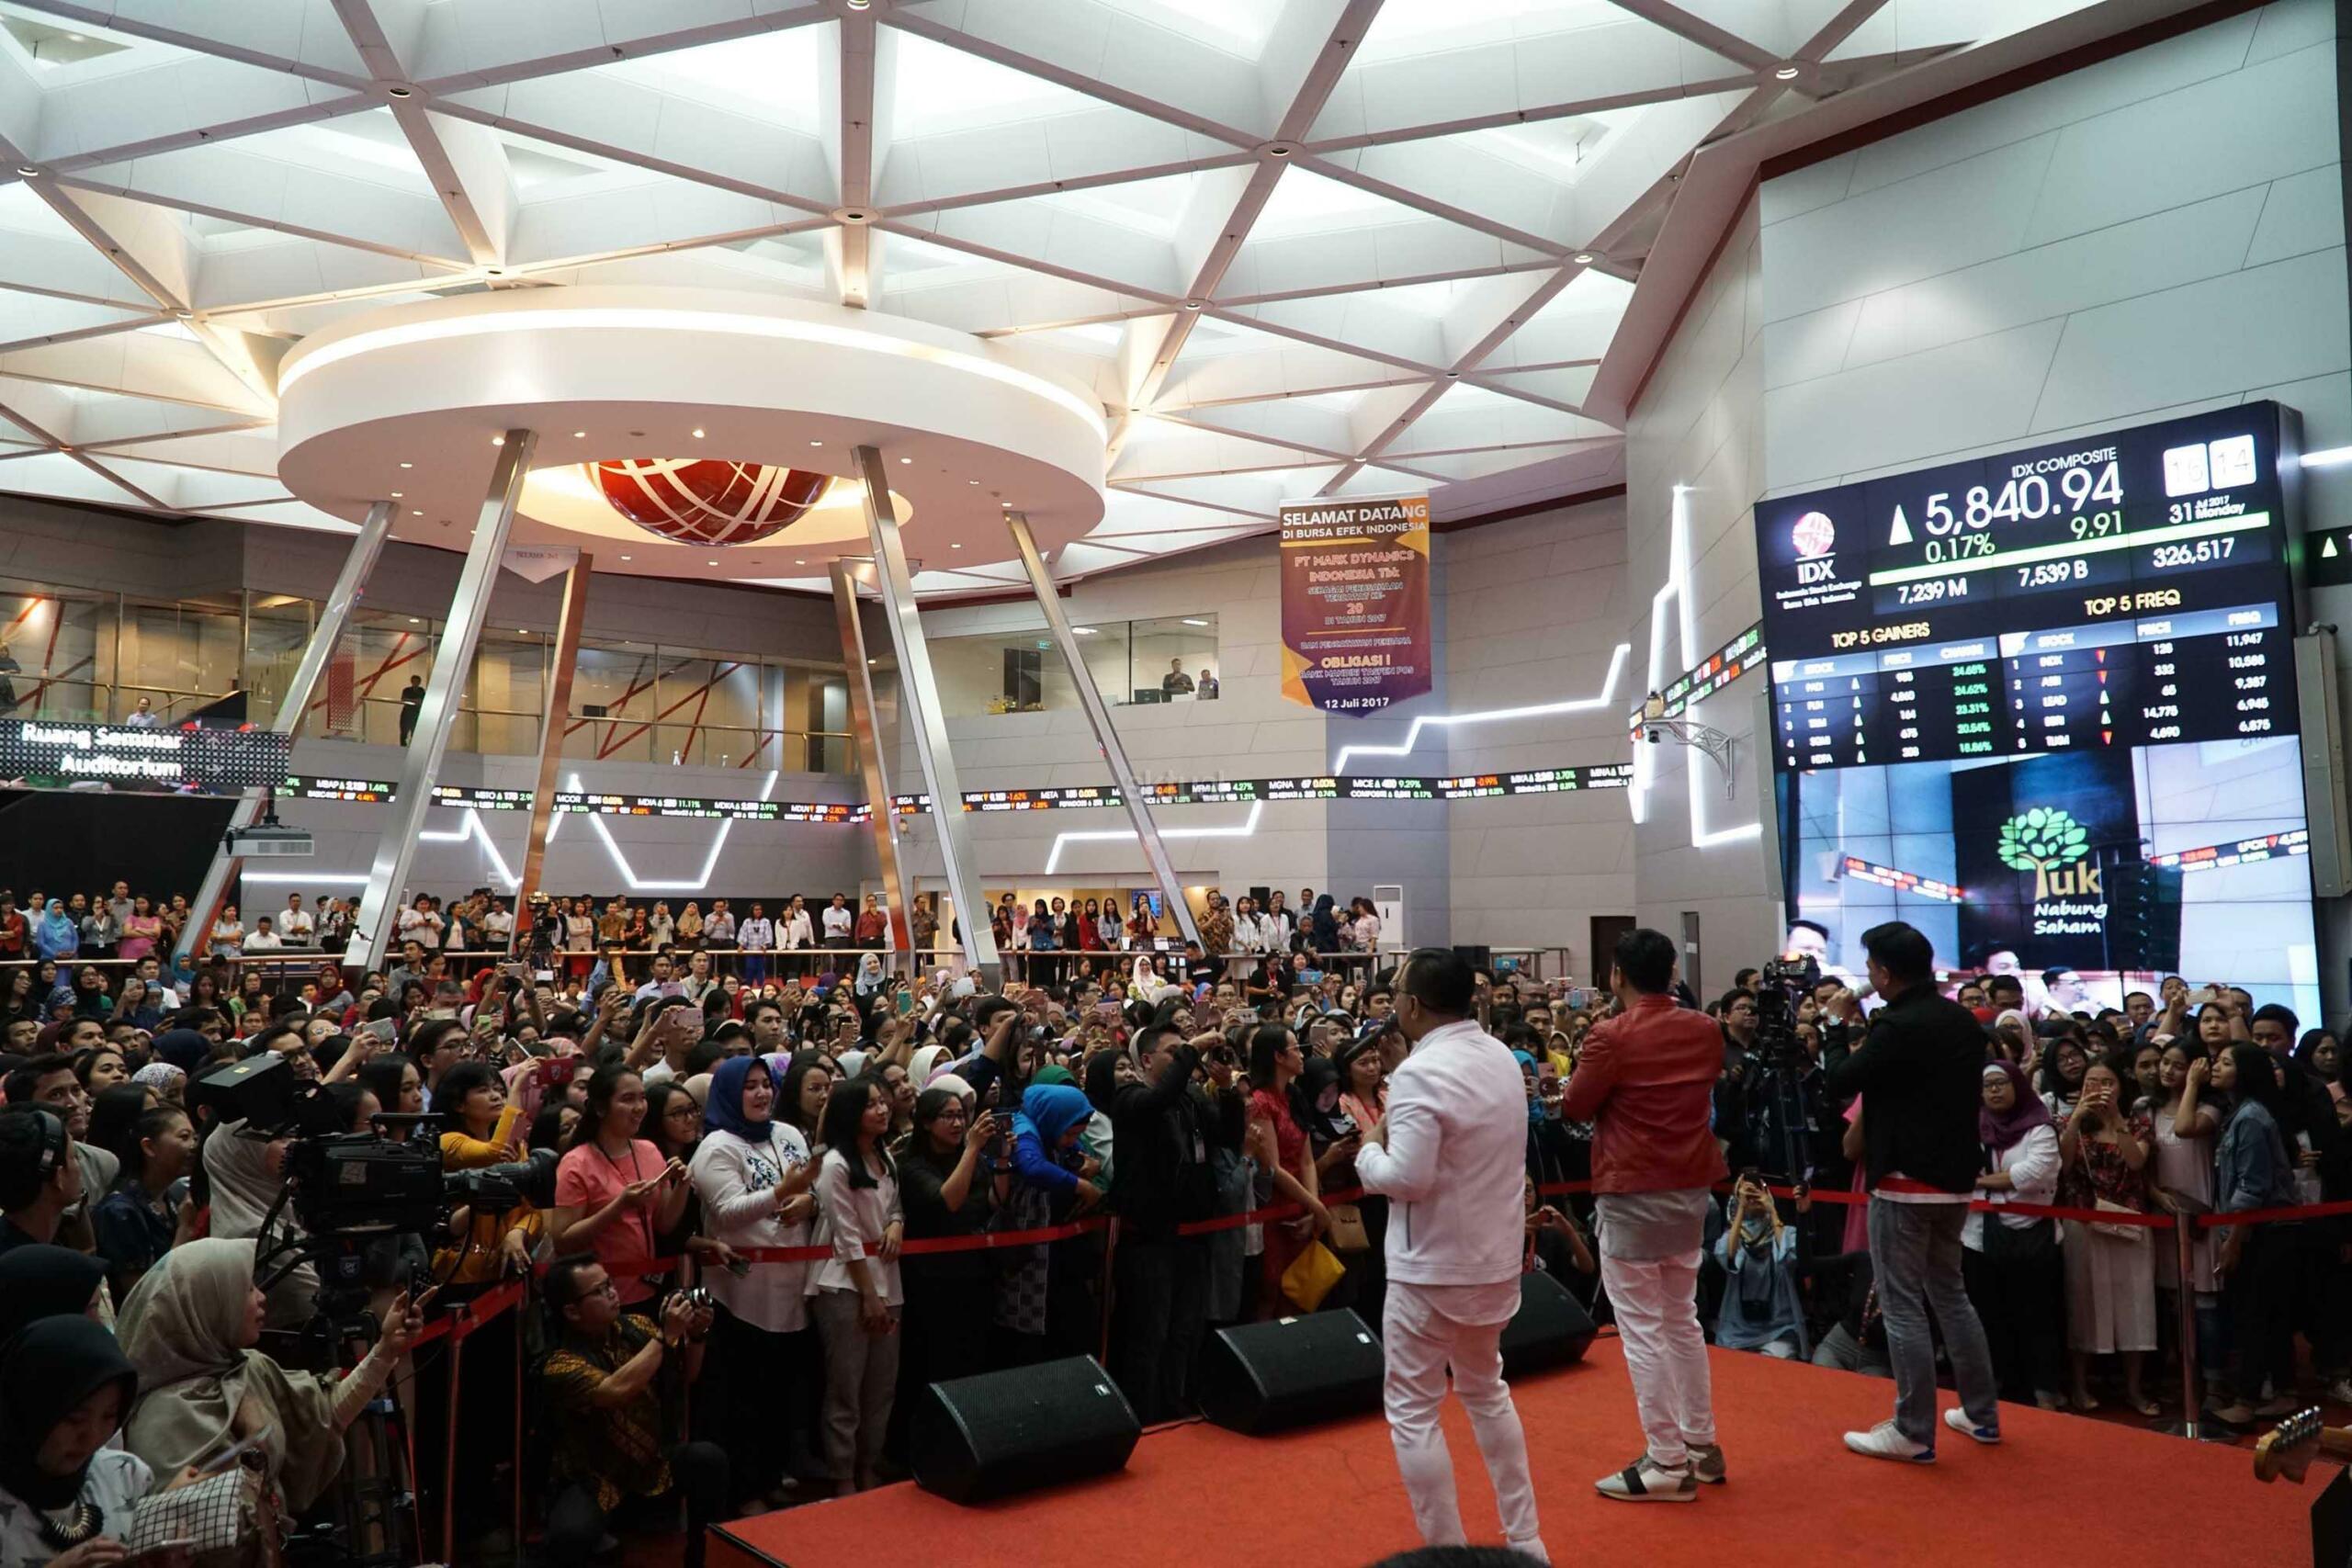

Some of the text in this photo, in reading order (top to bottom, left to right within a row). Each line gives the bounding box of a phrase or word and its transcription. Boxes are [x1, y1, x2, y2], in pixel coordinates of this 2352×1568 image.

[2011, 446, 2117, 479] IDX COMPOSITE
[1925, 461, 2124, 536] 5,840.94
[2169, 502, 2192, 524] 31
[2209, 495, 2230, 506] 2017
[1283, 504, 1426, 526] SELAMAT DATANG
[2195, 502, 2245, 519] Monday
[1283, 522, 1426, 539] DI BURSA EFEK INDONESIA
[1926, 510, 2122, 563] 0.17% 9.91
[1295, 550, 1415, 568] PT MARK DYNAMICS
[2153, 536, 2234, 568] 326,517
[1797, 559, 1836, 583] IDX
[2018, 559, 2088, 587] 7,539 B
[1897, 577, 1967, 604] 7,239 M
[2084, 589, 2181, 615] TOP 5 FREQ
[1831, 622, 1930, 648] TOP 5 GAINERS
[1321, 655, 1383, 669] OBLIGASI
[2014, 679, 2021, 691] 2
[1324, 697, 1390, 709] 12 Juli 2017
[2015, 698, 2024, 710] 3
[2016, 717, 2025, 729] 4
[21, 722, 184, 750] Ruang Seminar
[60, 754, 183, 777] Auditorium
[1398, 780, 1421, 788] 9.29%
[2033, 900, 2108, 919] Nabung
[2034, 919, 2101, 935] Saham
